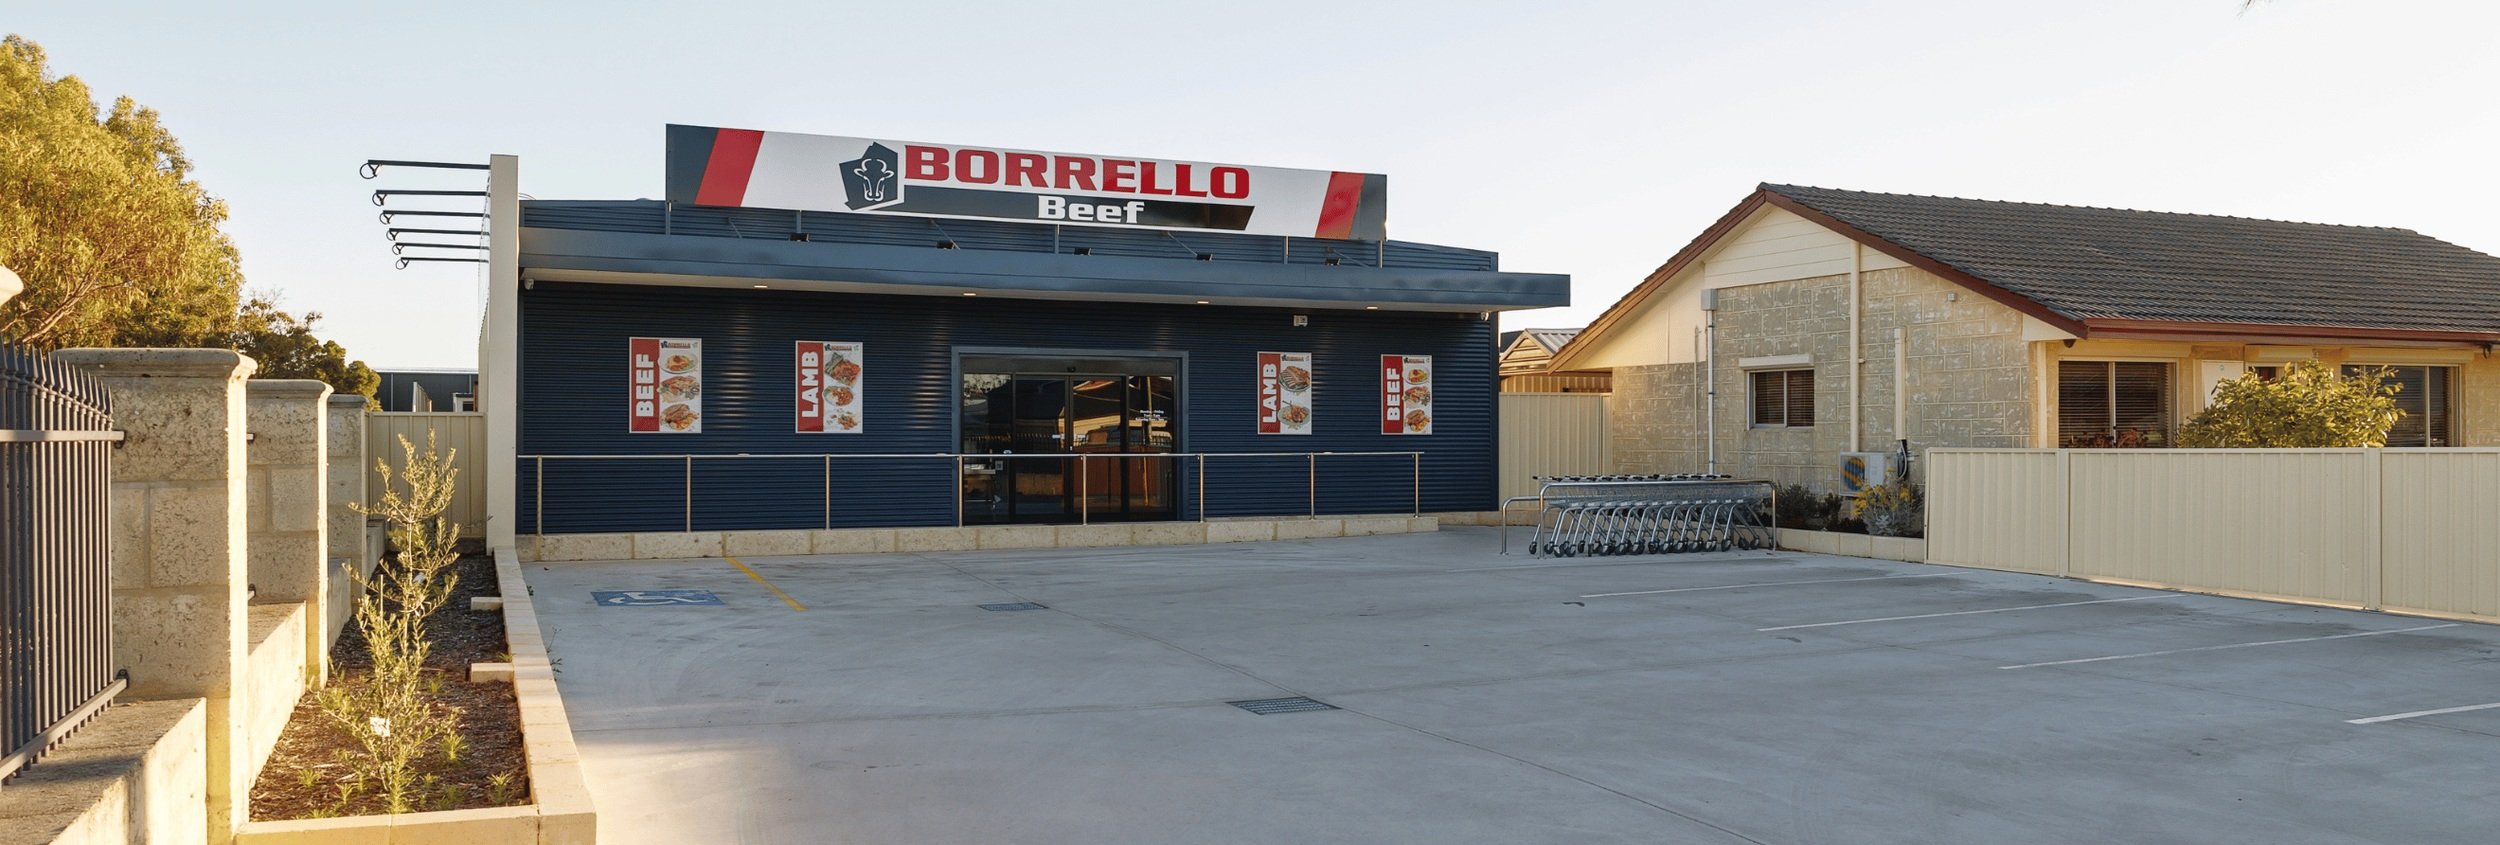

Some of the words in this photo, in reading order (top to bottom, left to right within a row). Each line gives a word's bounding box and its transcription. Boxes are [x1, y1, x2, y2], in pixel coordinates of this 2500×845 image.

[904, 145, 1250, 199] BORRELLO
[1038, 195, 1145, 224] Beef
[636, 354, 654, 417] BEEF
[801, 351, 819, 418] LAMB
[1262, 363, 1277, 423] LAMB
[1386, 368, 1400, 421] BEEF
